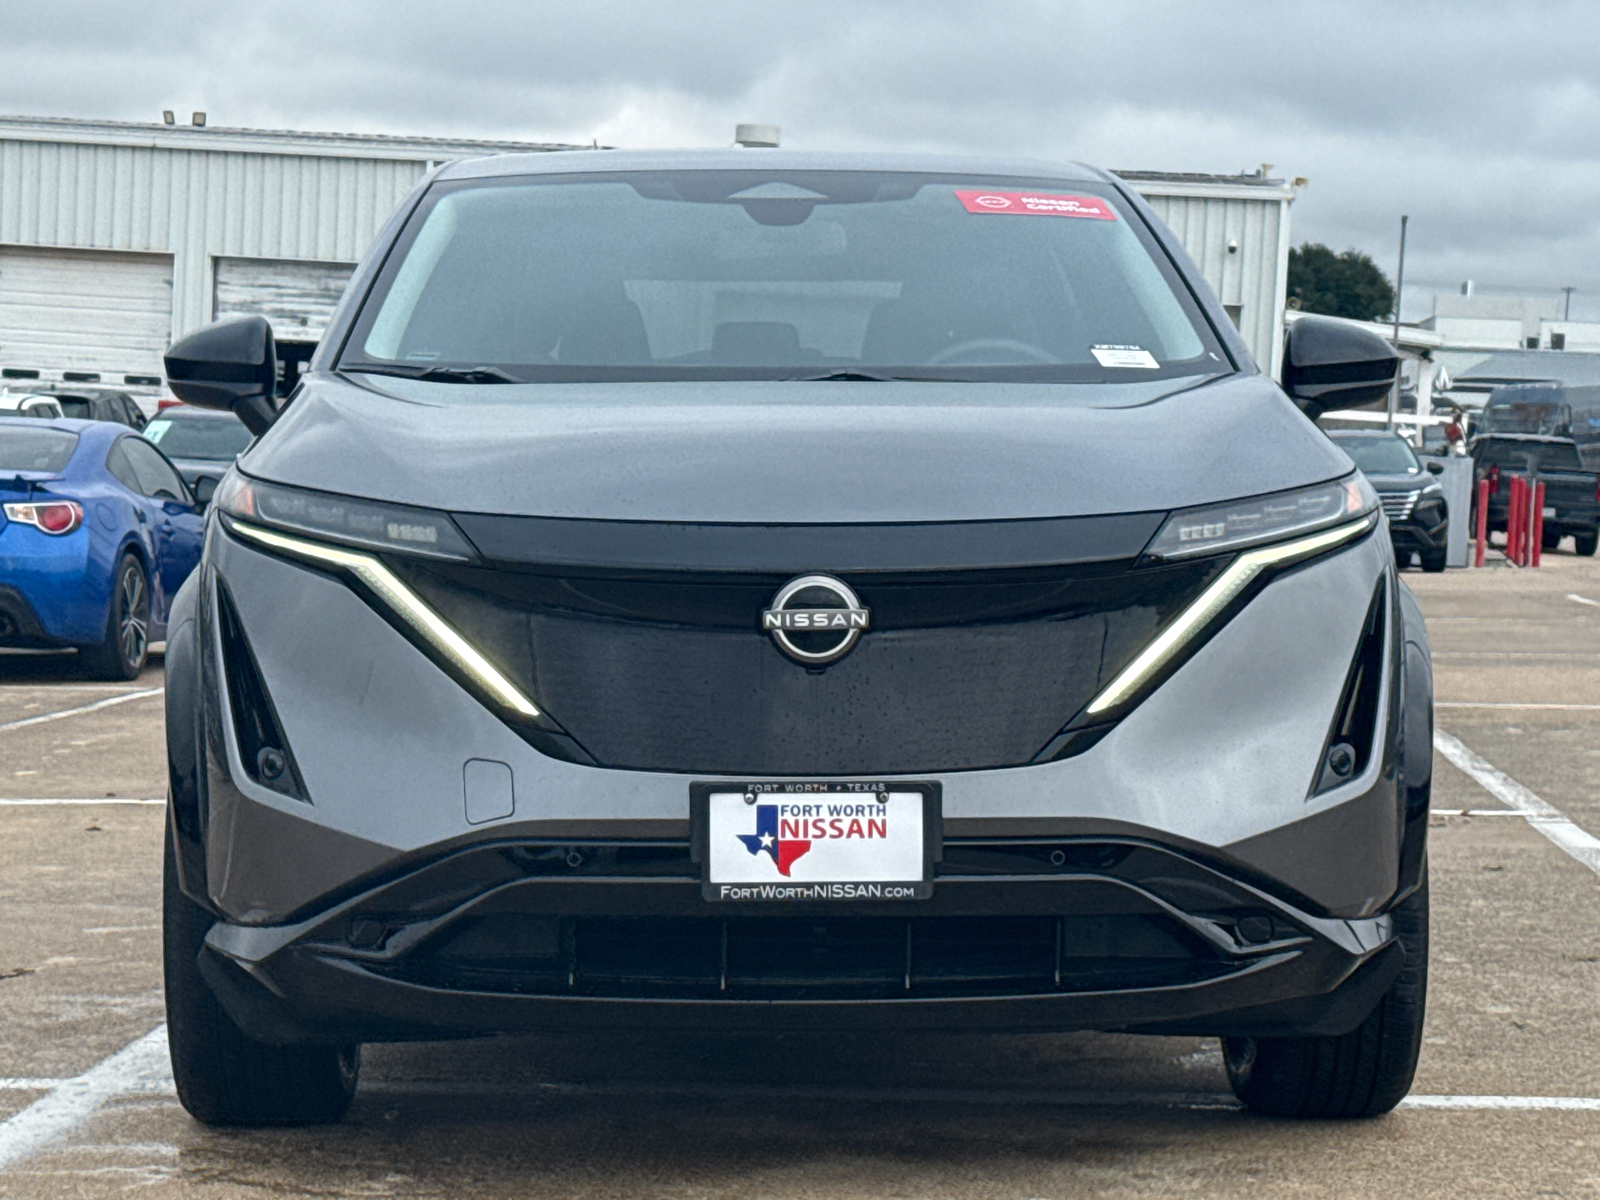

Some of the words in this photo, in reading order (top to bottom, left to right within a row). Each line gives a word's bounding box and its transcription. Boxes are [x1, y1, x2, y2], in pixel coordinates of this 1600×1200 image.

[1021, 197, 1080, 206] Nissan
[1026, 203, 1101, 213] Certified
[765, 613, 866, 627] NISSAN
[785, 784, 828, 792] WORTH
[847, 783, 886, 792] TEXAS
[780, 804, 822, 817] FORT
[828, 804, 886, 817] WORTH
[780, 818, 886, 839] NISSAN
